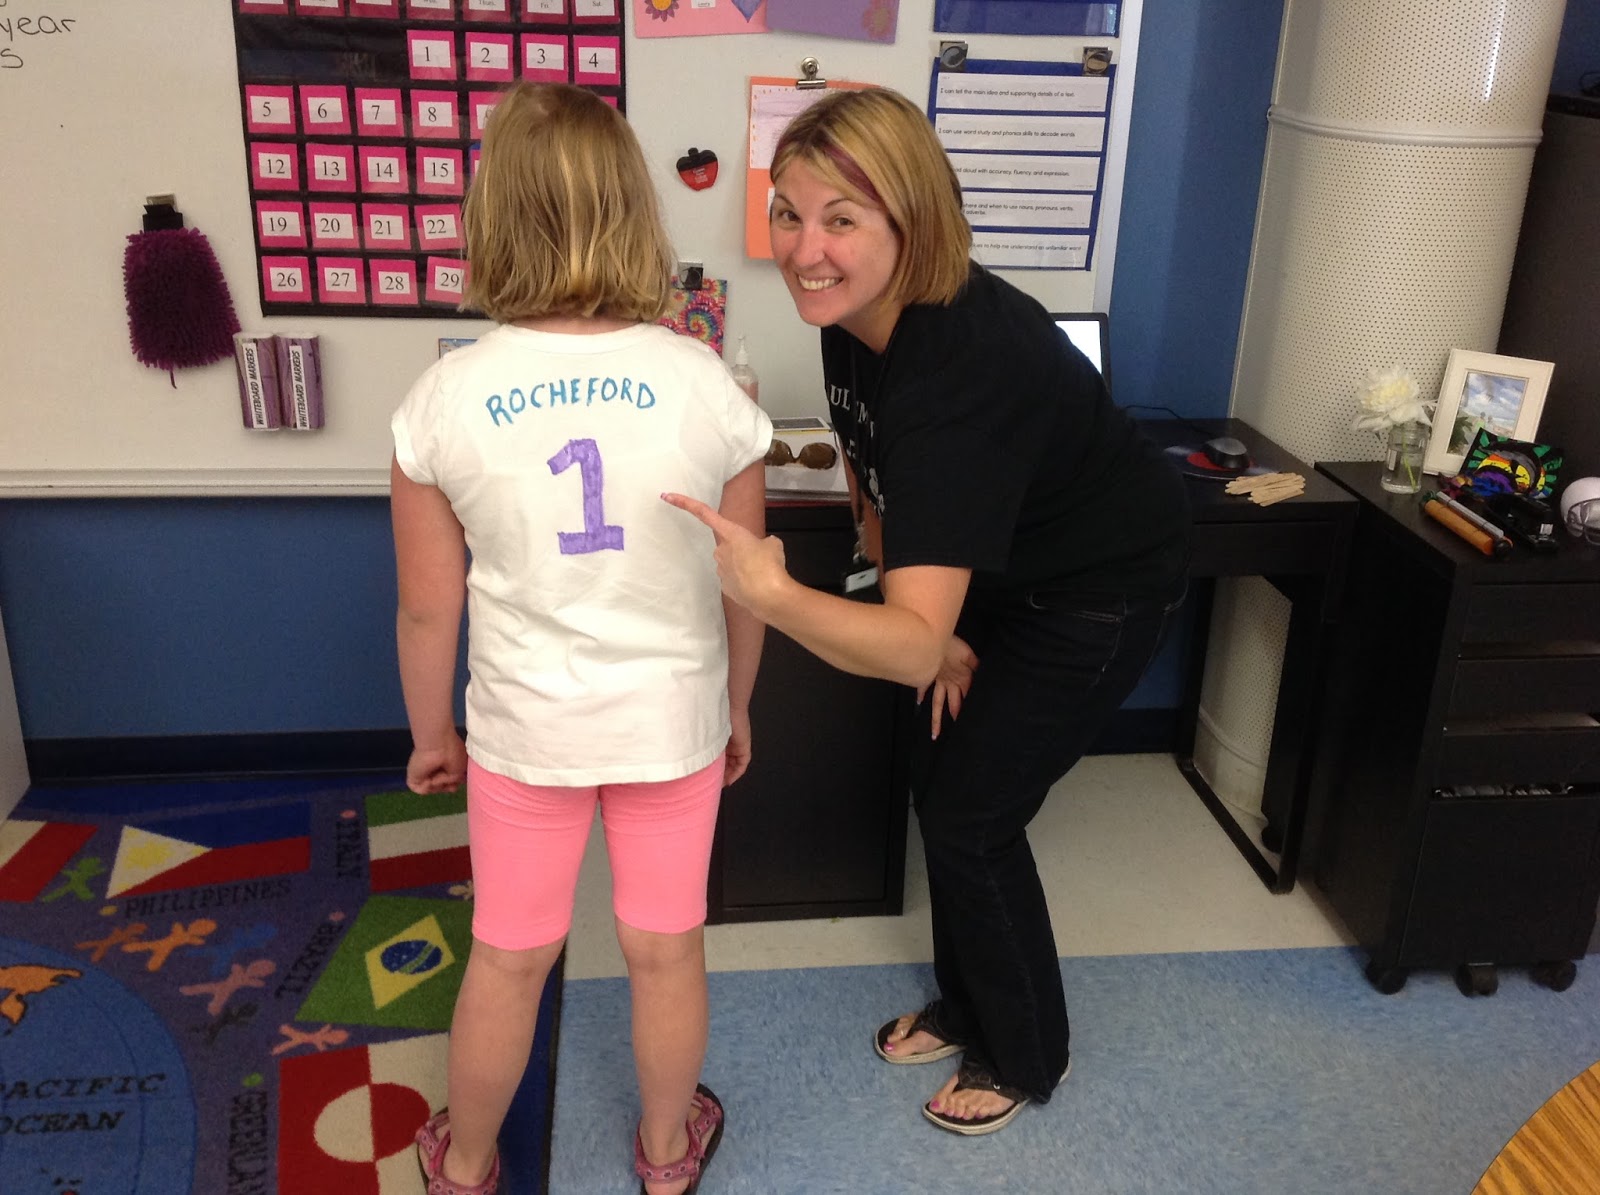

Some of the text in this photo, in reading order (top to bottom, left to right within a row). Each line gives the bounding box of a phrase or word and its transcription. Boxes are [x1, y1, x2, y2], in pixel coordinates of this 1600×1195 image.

[0, 16, 75, 41] year
[425, 46, 431, 62] 1
[480, 47, 490, 63] 2
[537, 48, 546, 64] 3
[588, 52, 598, 68] 4
[1010, 90, 1037, 98] supporting
[262, 101, 272, 117] 5
[317, 103, 328, 119] 6
[371, 104, 380, 120] 7
[427, 106, 437, 122] 8
[267, 158, 286, 175] 12
[322, 160, 340, 177] 13
[375, 162, 394, 178] 14
[431, 162, 449, 178] 15
[269, 216, 287, 232] 19
[320, 217, 341, 233] 20
[374, 219, 393, 235] 21
[426, 218, 447, 234] 22
[276, 272, 297, 288] 26
[331, 271, 350, 287] 27
[384, 274, 404, 291] 28
[440, 271, 460, 287] 29
[245, 347, 264, 425] WHITEBOARD MARKERS
[291, 350, 308, 427] WHITEBOARD MARKERS
[486, 377, 656, 426] ROCHEFORD
[547, 438, 624, 555] 1
[335, 819, 362, 879] ITALY
[124, 878, 292, 919] PHILIPPINES
[273, 923, 344, 999] BRAZIL
[0, 1073, 165, 1100] ACIFIC
